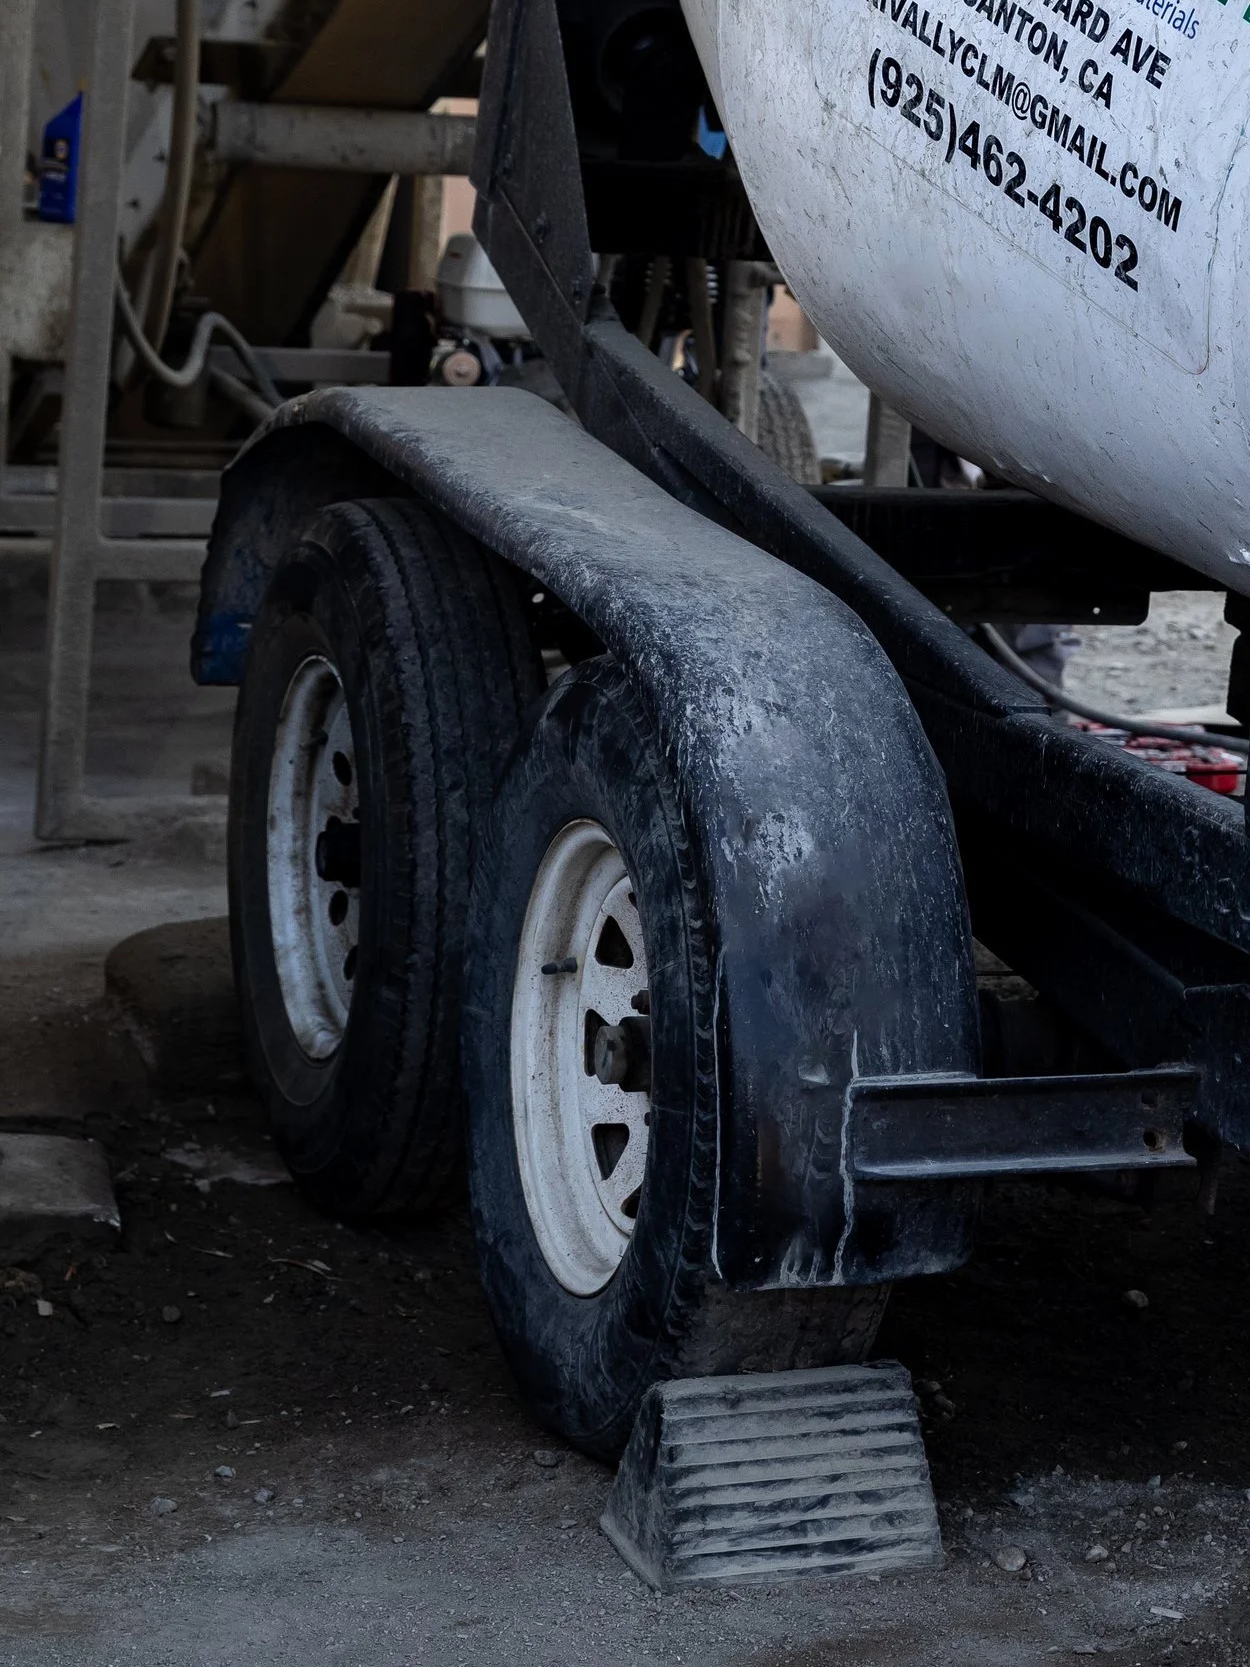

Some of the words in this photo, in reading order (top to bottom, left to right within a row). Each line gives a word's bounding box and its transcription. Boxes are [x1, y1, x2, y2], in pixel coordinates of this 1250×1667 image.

[1078, 58, 1114, 110] CA
[1110, 27, 1172, 89] AVE
[867, 47, 1139, 292] (925)462-4202
